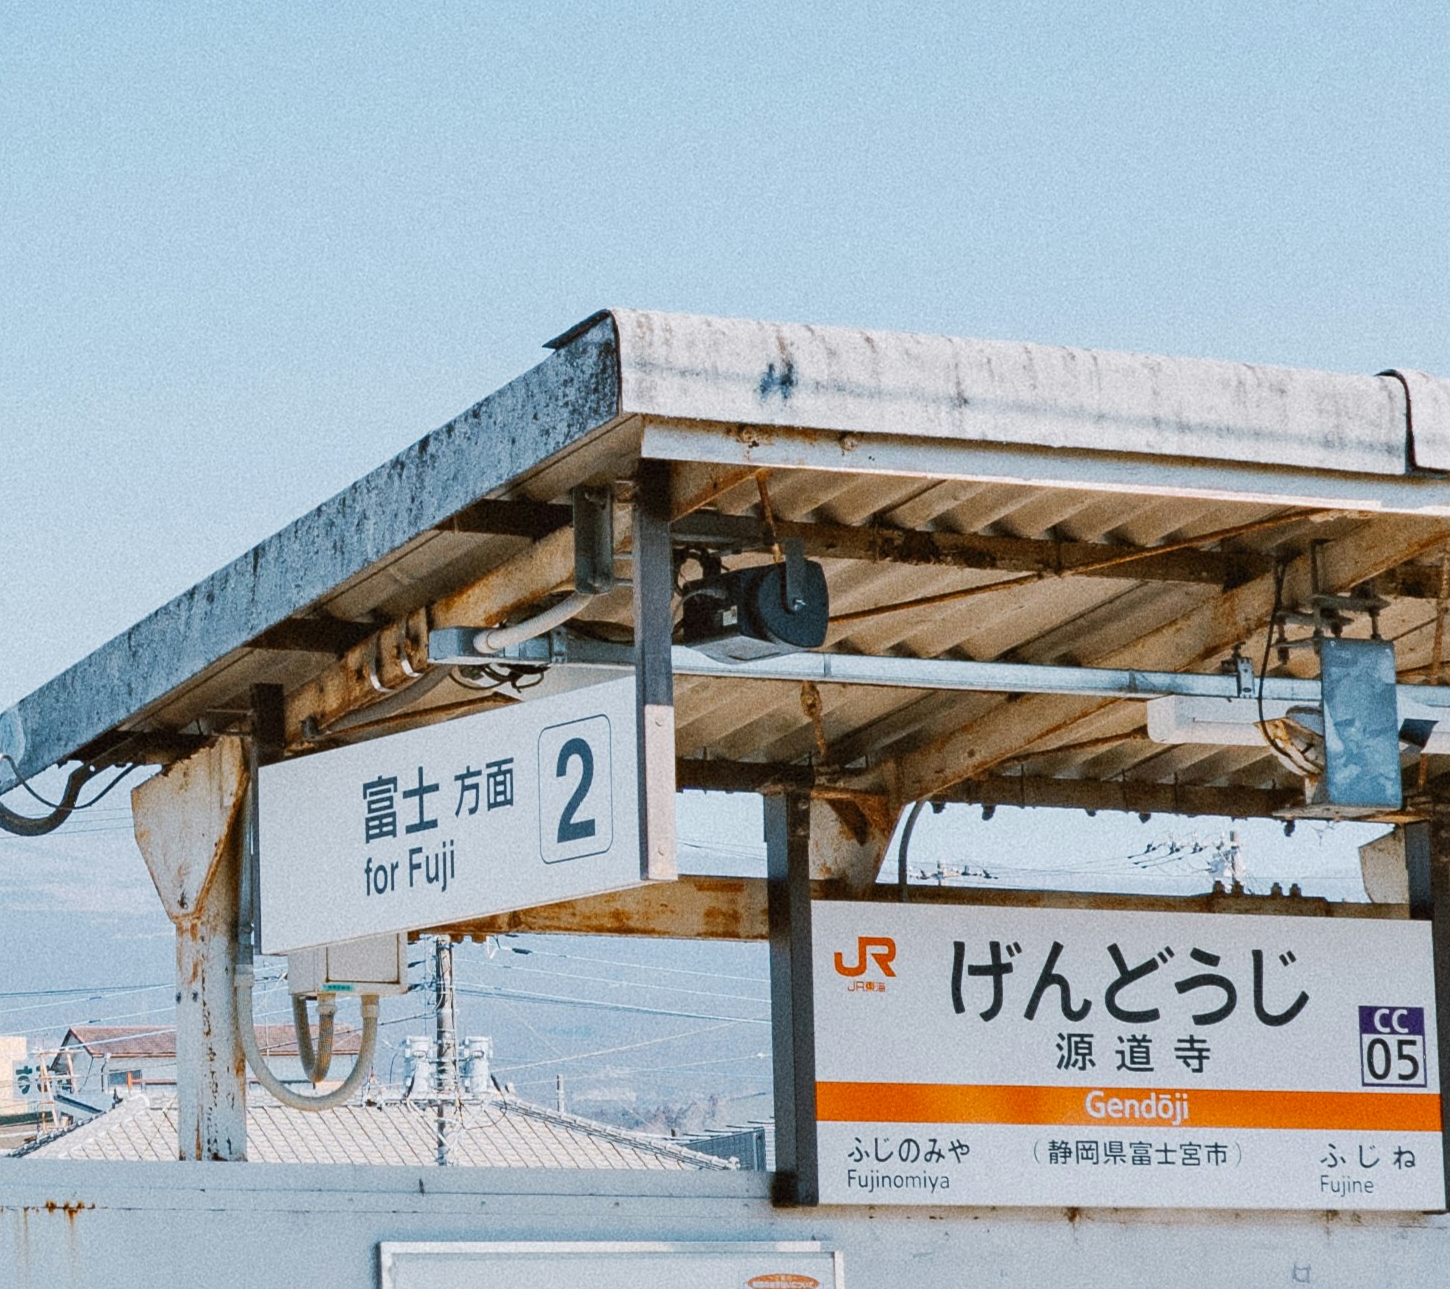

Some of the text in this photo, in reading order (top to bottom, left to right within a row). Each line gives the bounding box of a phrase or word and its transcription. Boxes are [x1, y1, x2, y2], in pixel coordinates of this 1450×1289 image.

[362, 757, 514, 844] 富士 方面
[555, 737, 596, 843] 2
[364, 839, 455, 896] for Fuji
[834, 936, 897, 978] JR
[950, 940, 1310, 1027] げんどうじ
[1373, 1008, 1410, 1034] CC
[1055, 1032, 1211, 1074] 源道寺
[1366, 1038, 1420, 1081] 05
[1085, 1089, 1190, 1126] Gendōji
[847, 1137, 971, 1164] ふじのみや
[1320, 1143, 1416, 1170] ふじね
[847, 1169, 950, 1194] Fujinomiya
[1320, 1174, 1374, 1198] Fujine
